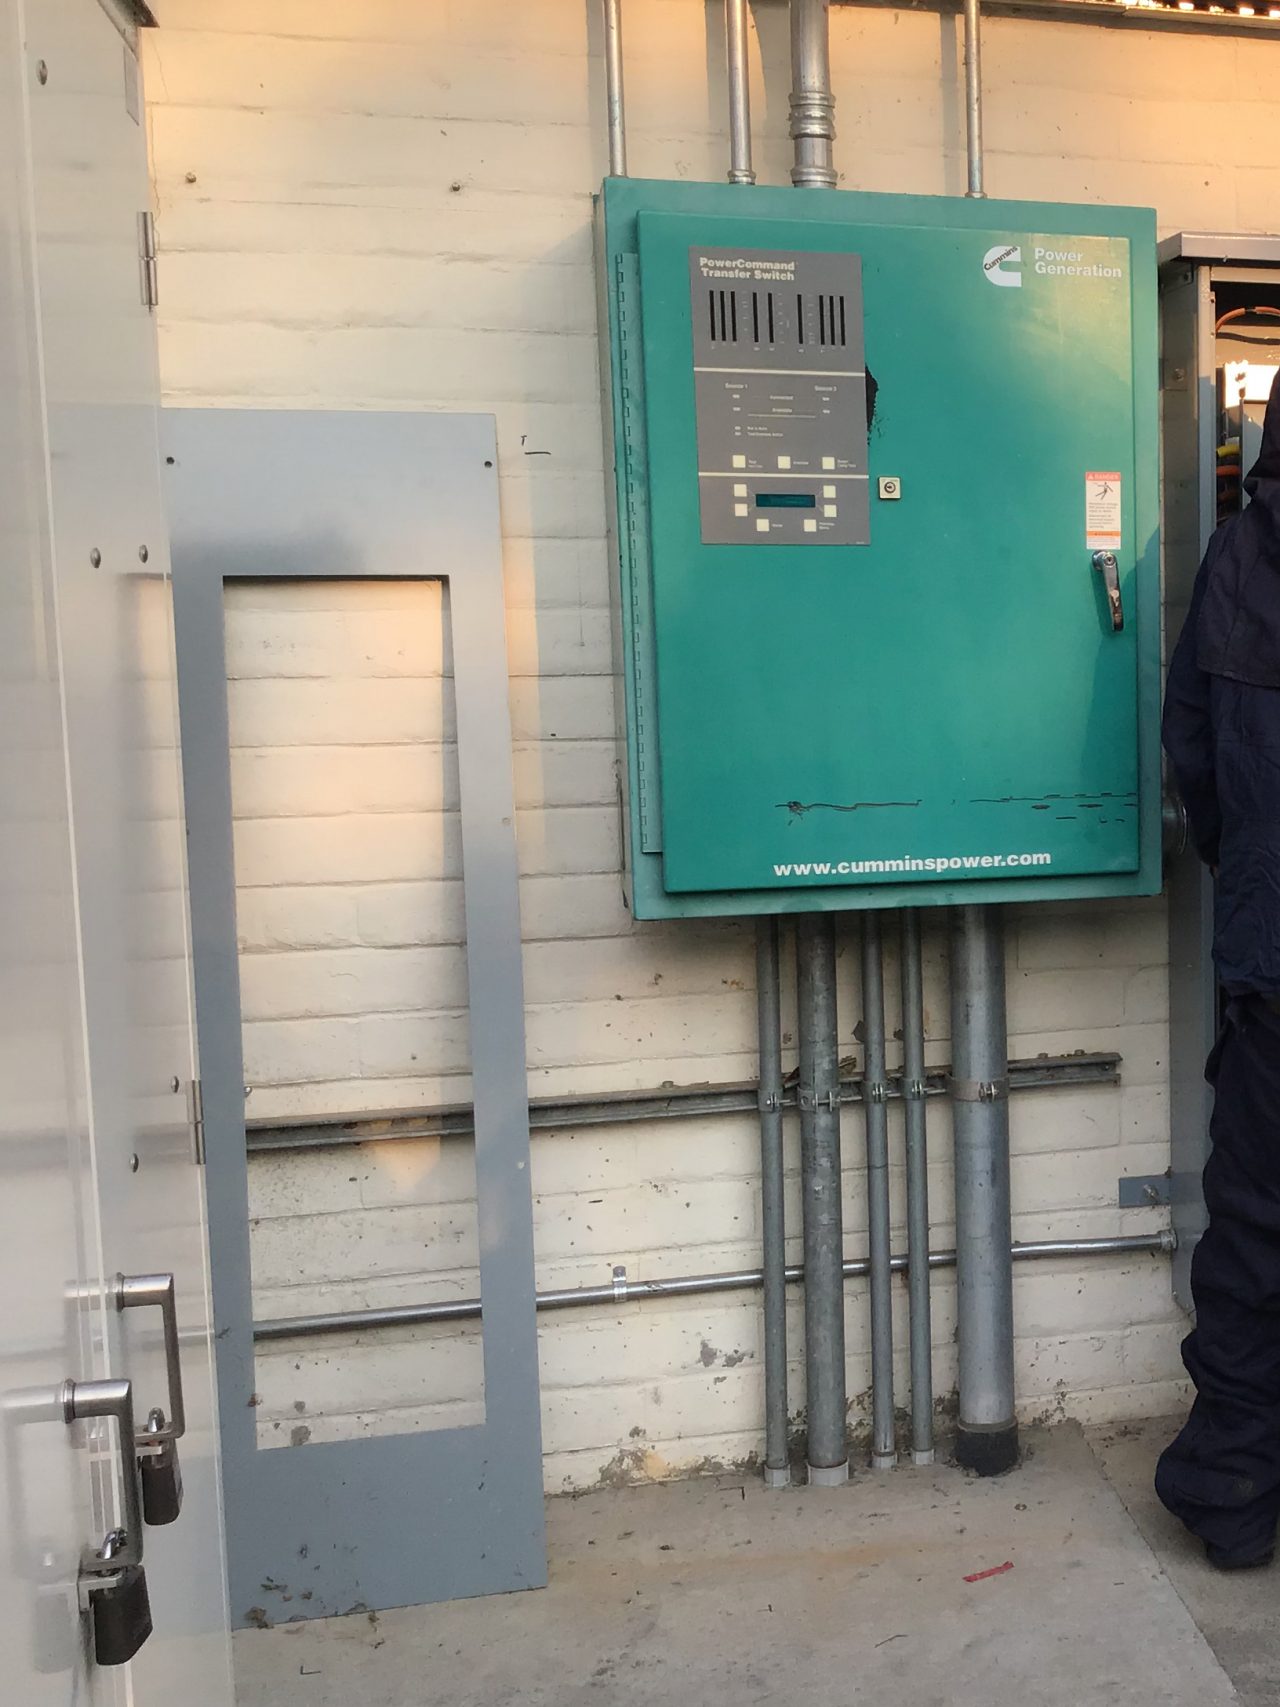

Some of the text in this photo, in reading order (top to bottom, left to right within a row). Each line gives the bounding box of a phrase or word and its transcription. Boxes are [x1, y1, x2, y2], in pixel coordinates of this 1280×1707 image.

[983, 245, 1018, 271] Cummins
[1034, 247, 1083, 262] Power
[699, 256, 795, 271] PowerCommand
[1035, 261, 1122, 278] Generation
[701, 267, 795, 281] Transfer Switch
[773, 852, 1051, 876] www.cumminspower.com
